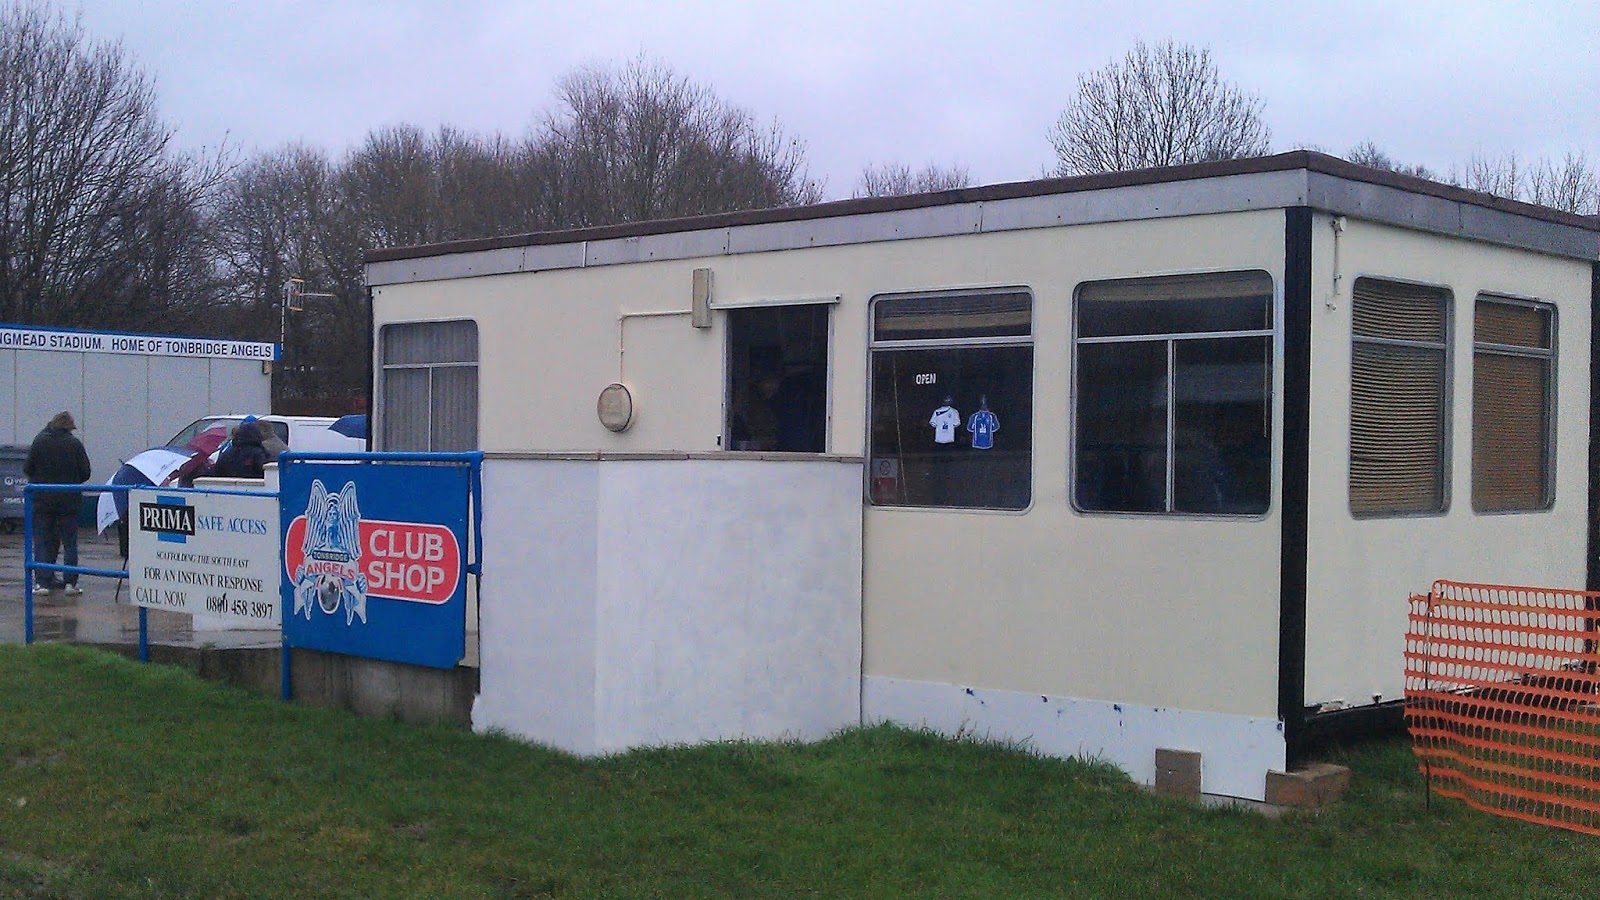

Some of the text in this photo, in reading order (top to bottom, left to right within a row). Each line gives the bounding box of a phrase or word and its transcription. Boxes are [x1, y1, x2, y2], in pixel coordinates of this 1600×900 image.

[112, 339, 145, 352] HOME
[147, 340, 162, 352] OF
[166, 342, 228, 355] TONBRIDGE
[231, 344, 272, 358] ANGELS
[915, 373, 936, 385] OPEN
[143, 507, 267, 535] PRIMA SAFE ACCESS
[369, 529, 444, 561] CLUB
[156, 551, 196, 563] SCAFFOLDING
[197, 555, 209, 565] THE
[314, 552, 348, 562] TONBRIDGE
[144, 567, 264, 593] FOR AN INSTANT RESPONSE
[306, 562, 355, 581] ANGELS
[368, 561, 445, 594] SHOP
[136, 587, 162, 604] CALL
[164, 591, 187, 607] NOW
[231, 599, 248, 616] 458
[250, 602, 273, 620] 3897
